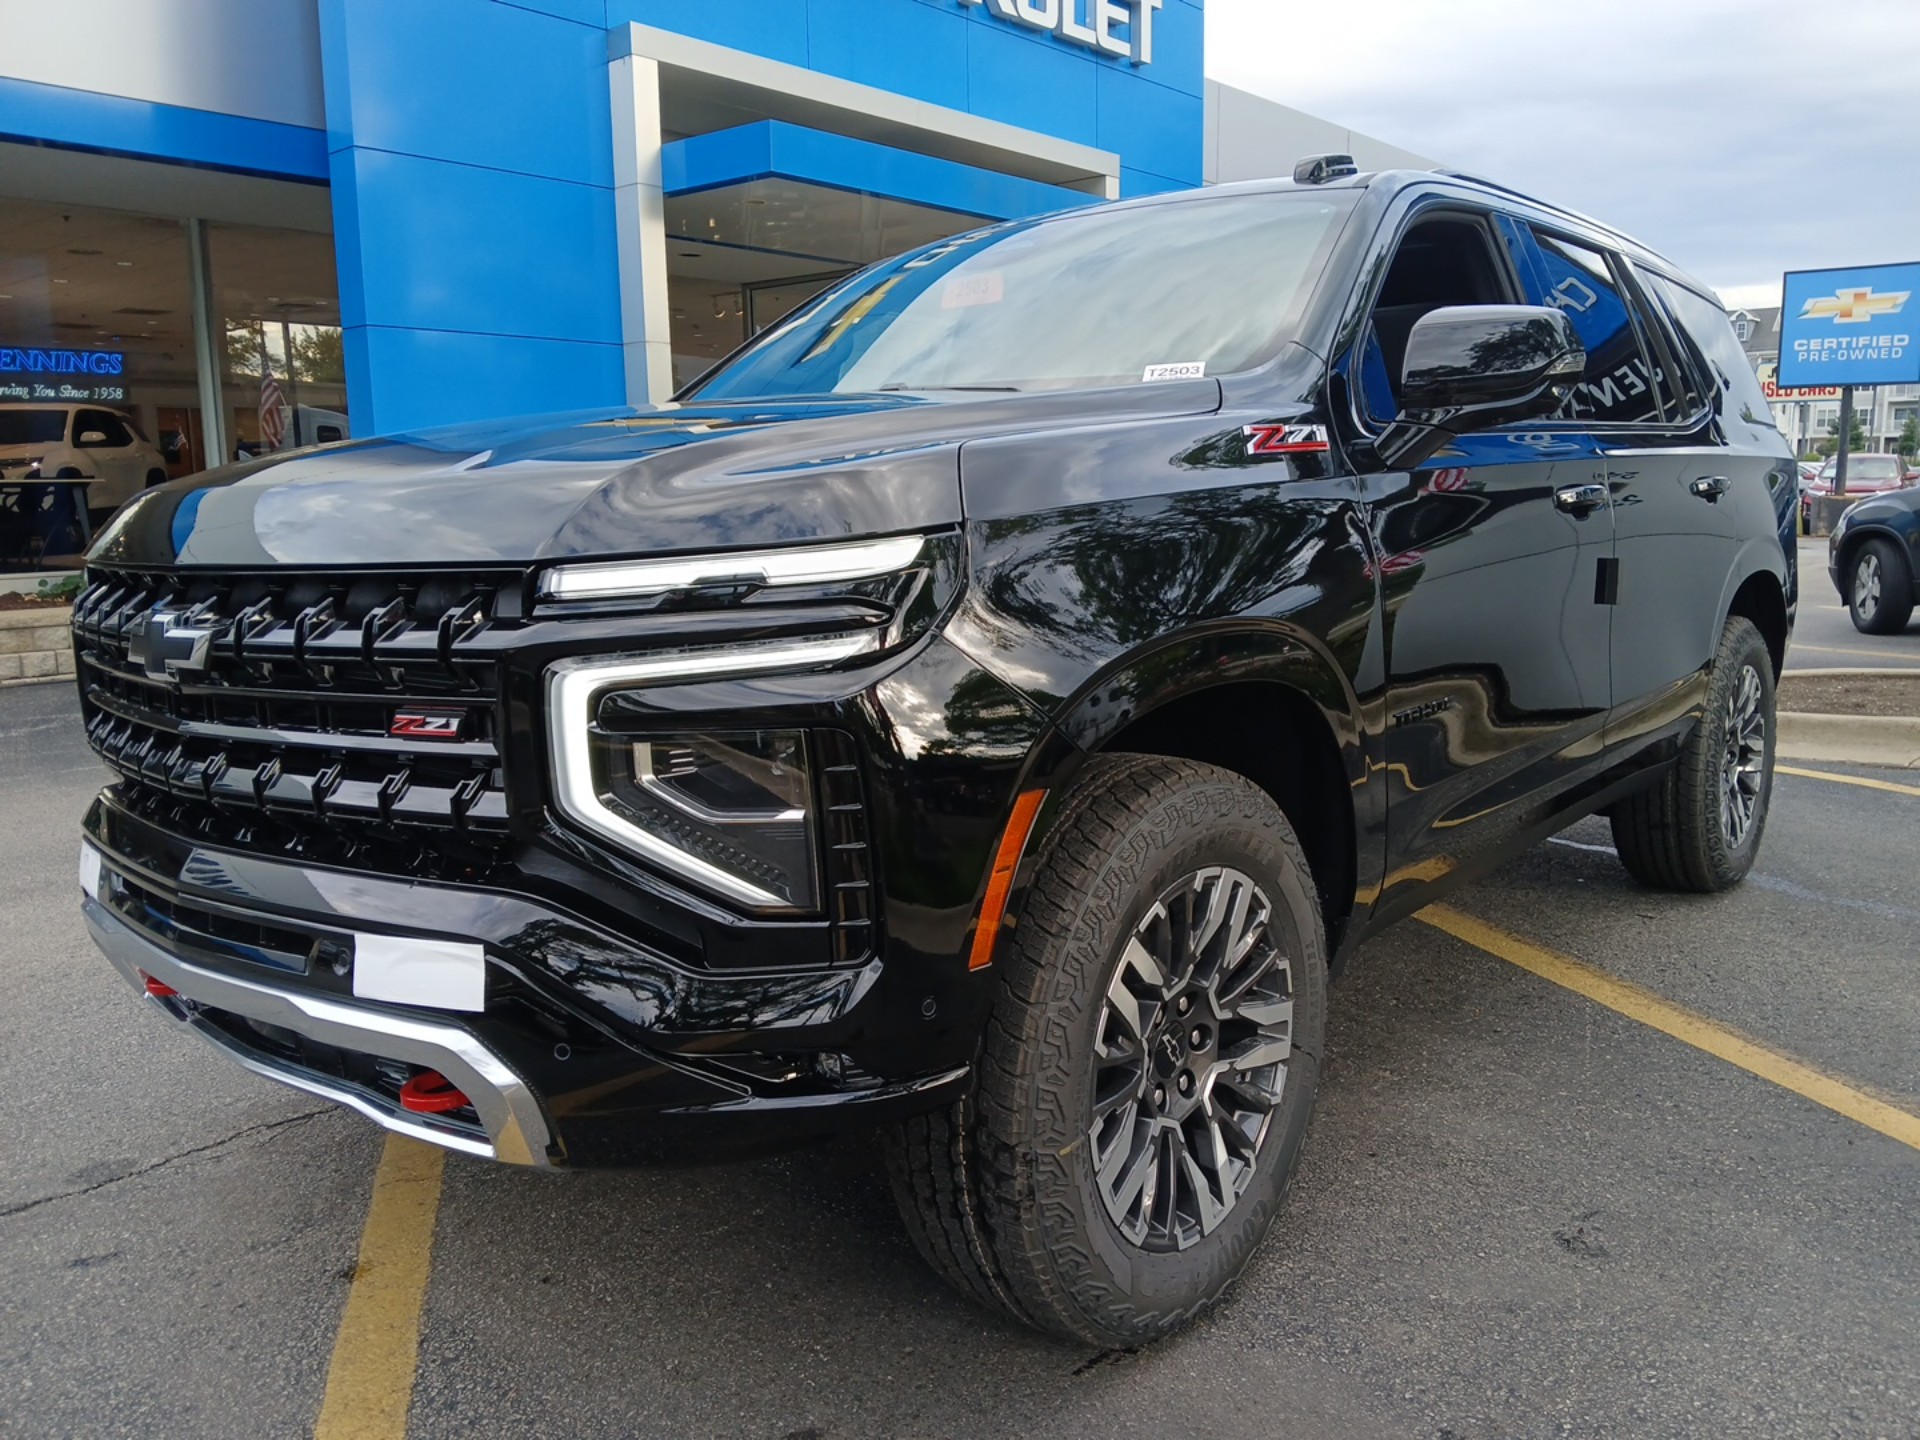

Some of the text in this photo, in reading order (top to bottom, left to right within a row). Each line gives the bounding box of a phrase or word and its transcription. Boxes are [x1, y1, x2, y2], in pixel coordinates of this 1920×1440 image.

[1793, 334, 1909, 351] CERTIFIED
[1798, 347, 1903, 363] PRE-OWNED
[1148, 364, 1202, 377] T2503
[33, 384, 56, 397] You
[59, 384, 90, 398] Since
[94, 388, 124, 399] 1958
[1242, 424, 1330, 455] Z71
[391, 714, 461, 737] Z71
